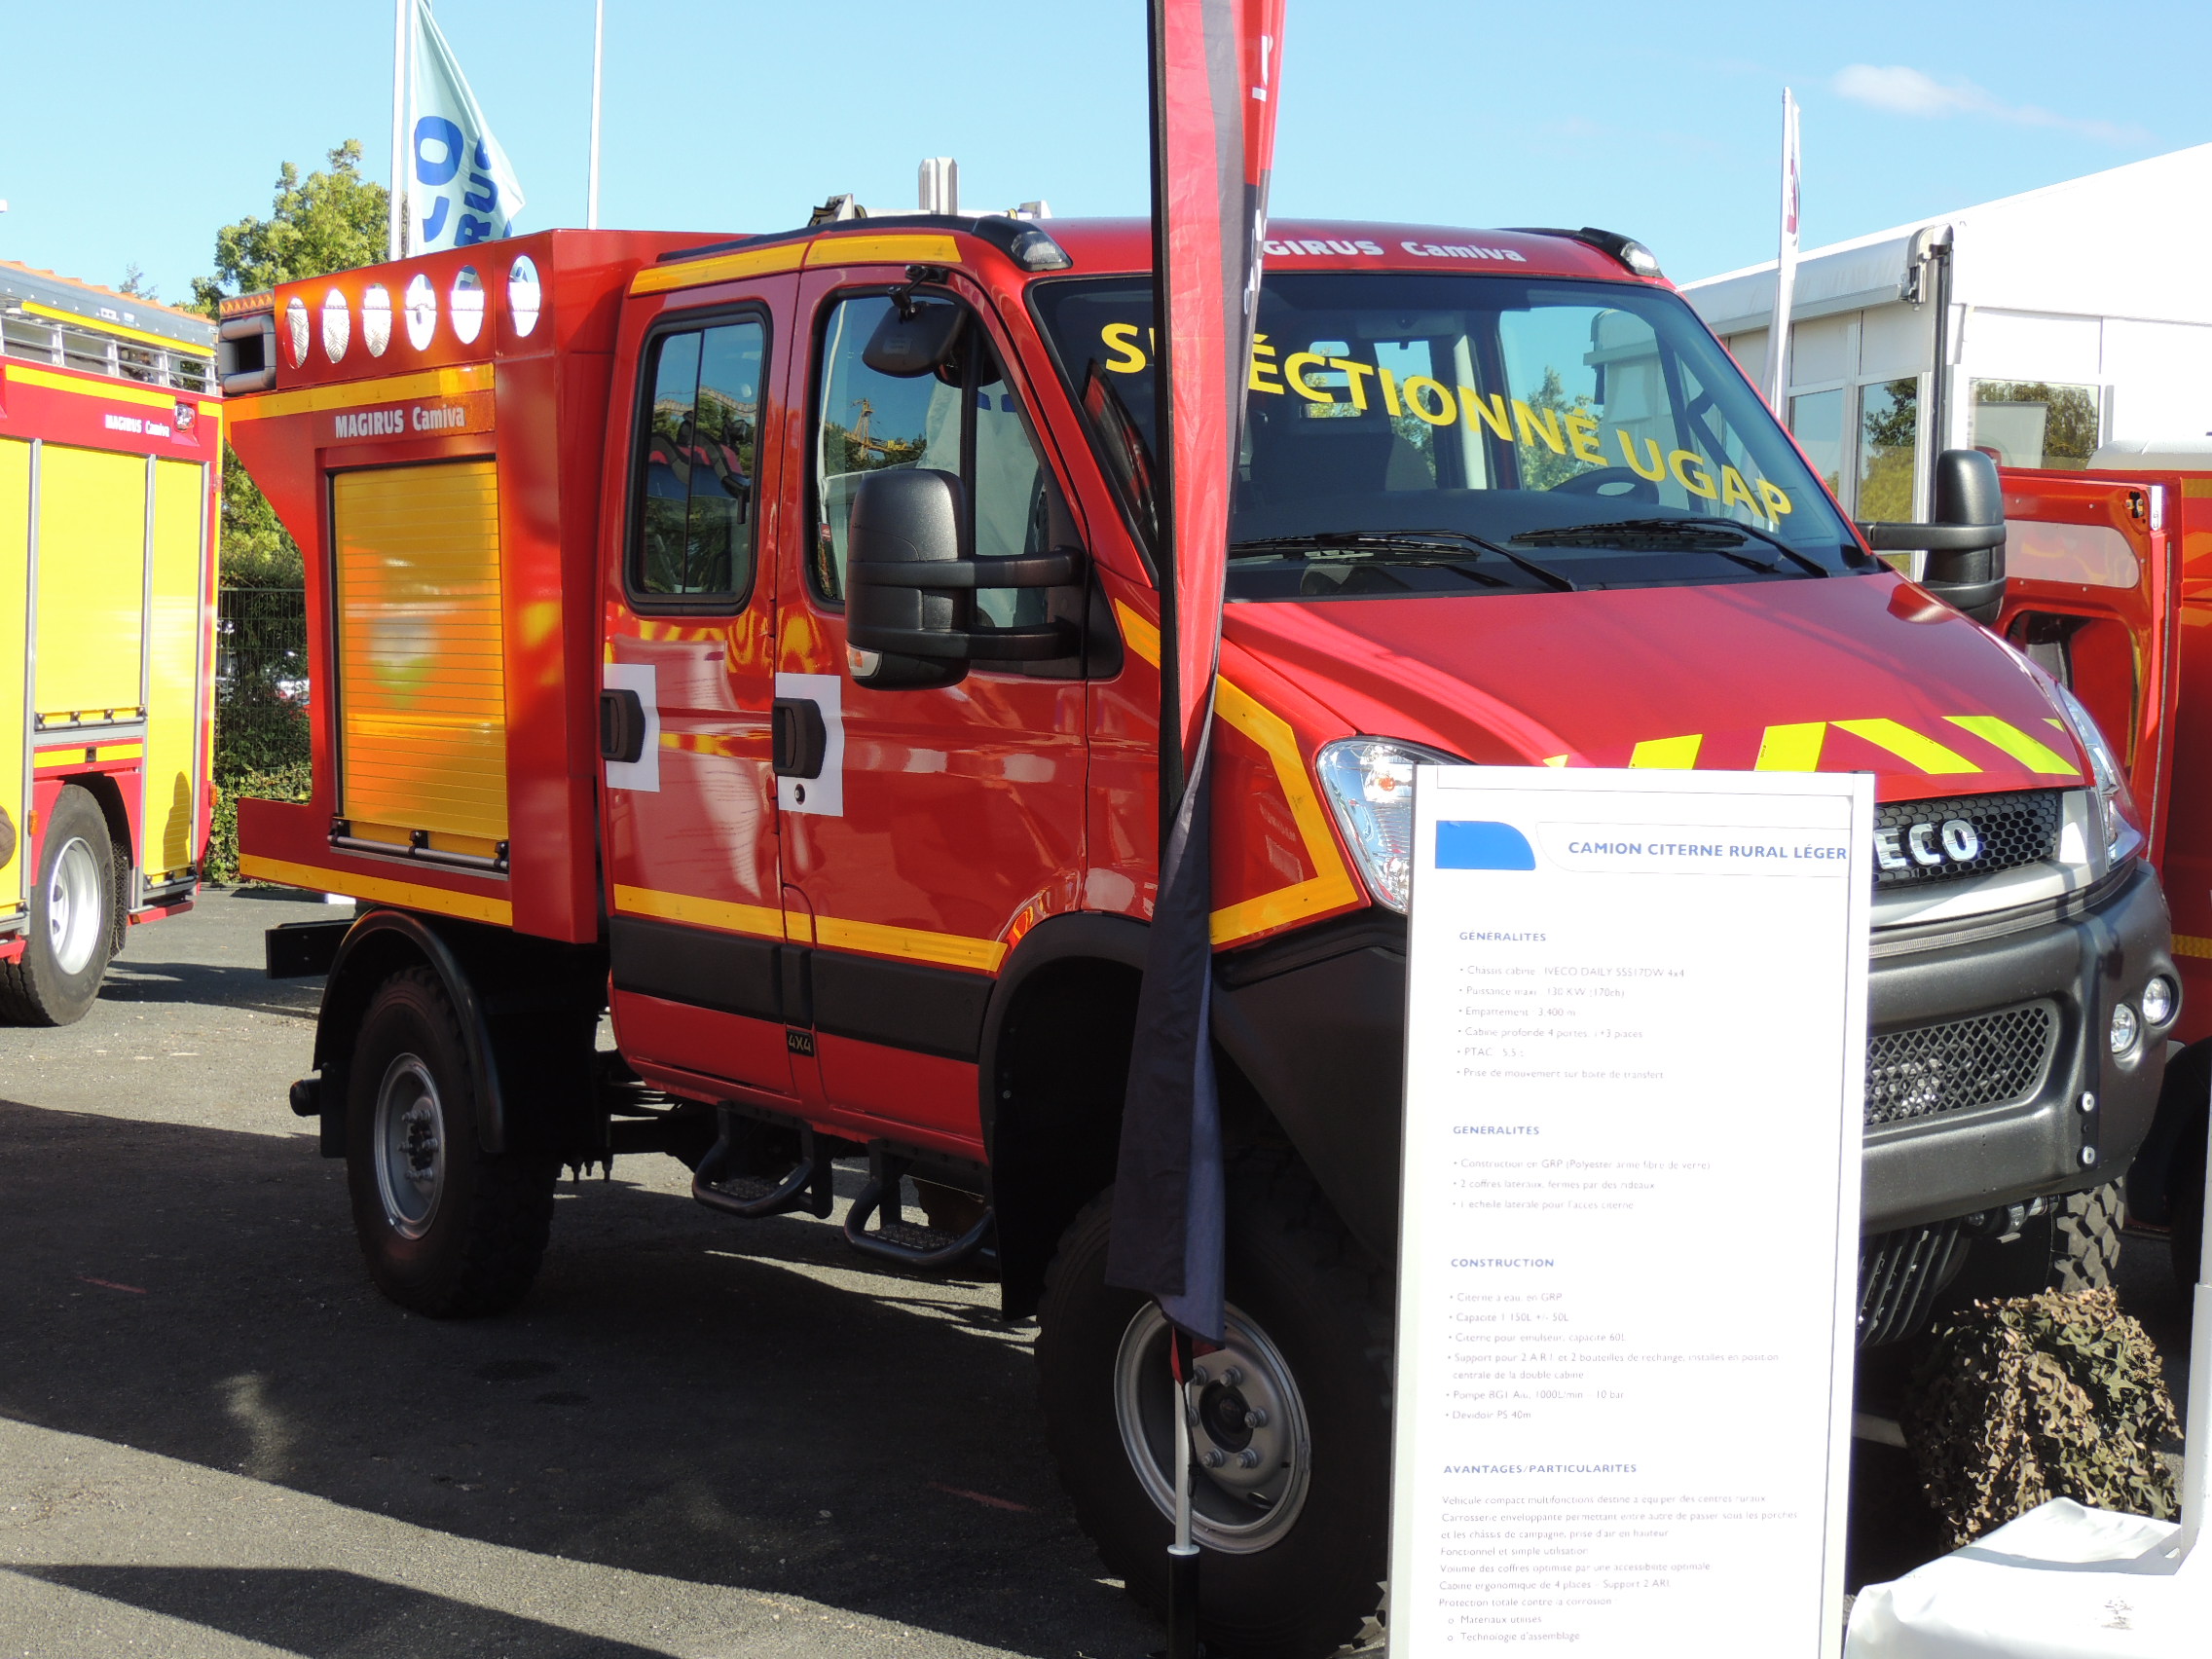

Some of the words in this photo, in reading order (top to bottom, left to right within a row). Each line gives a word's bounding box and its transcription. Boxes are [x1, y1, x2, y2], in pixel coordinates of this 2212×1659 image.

[1262, 240, 1384, 256] GIRUS
[1400, 241, 1527, 263] Camiva
[104, 414, 142, 434] MAGIRUS
[335, 409, 404, 438] MAGIRUS
[412, 404, 465, 431] Camiva
[1101, 322, 1608, 466] SÉCTIONNÉ
[1616, 428, 1792, 526] UGAP
[1873, 819, 1978, 869] ECO
[1567, 841, 1642, 855] CAMION
[1647, 843, 1723, 857] CITERNE
[1729, 845, 1788, 859] RURAL
[1793, 843, 1847, 860] LÉGER
[1504, 966, 1535, 976] cabine
[1544, 966, 1578, 977] IVECO
[1580, 967, 1613, 977] DAILY
[1466, 985, 1512, 996] Puissance
[1464, 1026, 1499, 1037] Cabine
[1500, 1027, 1545, 1039] profonde
[1613, 1031, 1643, 1040] places
[788, 1034, 812, 1052] 4X4
[1464, 1047, 1493, 1056] PTAC
[1463, 1067, 1488, 1078] Prise
[1490, 1068, 1502, 1078] de
[1504, 1070, 1561, 1079] mouvement
[1608, 1070, 1621, 1079] de
[1623, 1070, 1664, 1080] transfert
[1460, 1158, 1524, 1168] Construction
[1540, 1159, 1564, 1169] GRP
[1468, 1178, 1502, 1189] coffres
[1582, 1182, 1598, 1191] par
[1601, 1180, 1617, 1190] des
[1541, 1201, 1564, 1211] pour
[1450, 1258, 1555, 1269] CONSTRUCTION
[1456, 1292, 1493, 1303] Citerne
[1552, 1311, 1569, 1322] 50L
[1455, 1332, 1492, 1343] Citerne
[1493, 1335, 1516, 1345] pour
[1454, 1352, 1493, 1364] Support
[1494, 1354, 1518, 1364] pour
[1579, 1352, 1625, 1362] bouteilles
[1452, 1371, 1492, 1380] centrale
[1520, 1370, 1552, 1380] double
[1554, 1370, 1584, 1380] cabine
[1453, 1389, 1486, 1402] Pompe
[1609, 1390, 1624, 1399] bar
[1495, 1409, 1508, 1419] PS
[1442, 1463, 1638, 1474] AVANTAGES/PARTICULARITES
[1484, 1497, 1526, 1506] compact
[1528, 1494, 1594, 1504] multifonctions
[1678, 1494, 1696, 1503] des
[1441, 1513, 1497, 1523] Carrosserie
[1500, 1512, 1563, 1525] enveloppante
[1566, 1514, 1618, 1523] permettant
[1689, 1513, 1718, 1522] passer
[1761, 1511, 1797, 1521] porches
[1453, 1530, 1466, 1539] les
[1569, 1530, 1594, 1540] prise
[1633, 1529, 1669, 1537] hauteur
[1440, 1546, 1495, 1557] Fonctionnel
[1511, 1546, 1541, 1558] simple
[1543, 1546, 1589, 1556] utilisation
[1479, 1564, 1494, 1573] des
[1497, 1563, 1530, 1573] coffres
[1574, 1565, 1591, 1574] par
[1670, 1562, 1711, 1572] optimale
[1475, 1582, 1537, 1593] ergonomique
[1539, 1580, 1552, 1590] de
[1563, 1580, 1592, 1592] places
[1603, 1579, 1641, 1591] Support
[1438, 1598, 1489, 1607] Protection
[1492, 1597, 1519, 1607] totale
[1566, 1598, 1612, 1606] corrosion
[1459, 1632, 1518, 1643] Technologie
